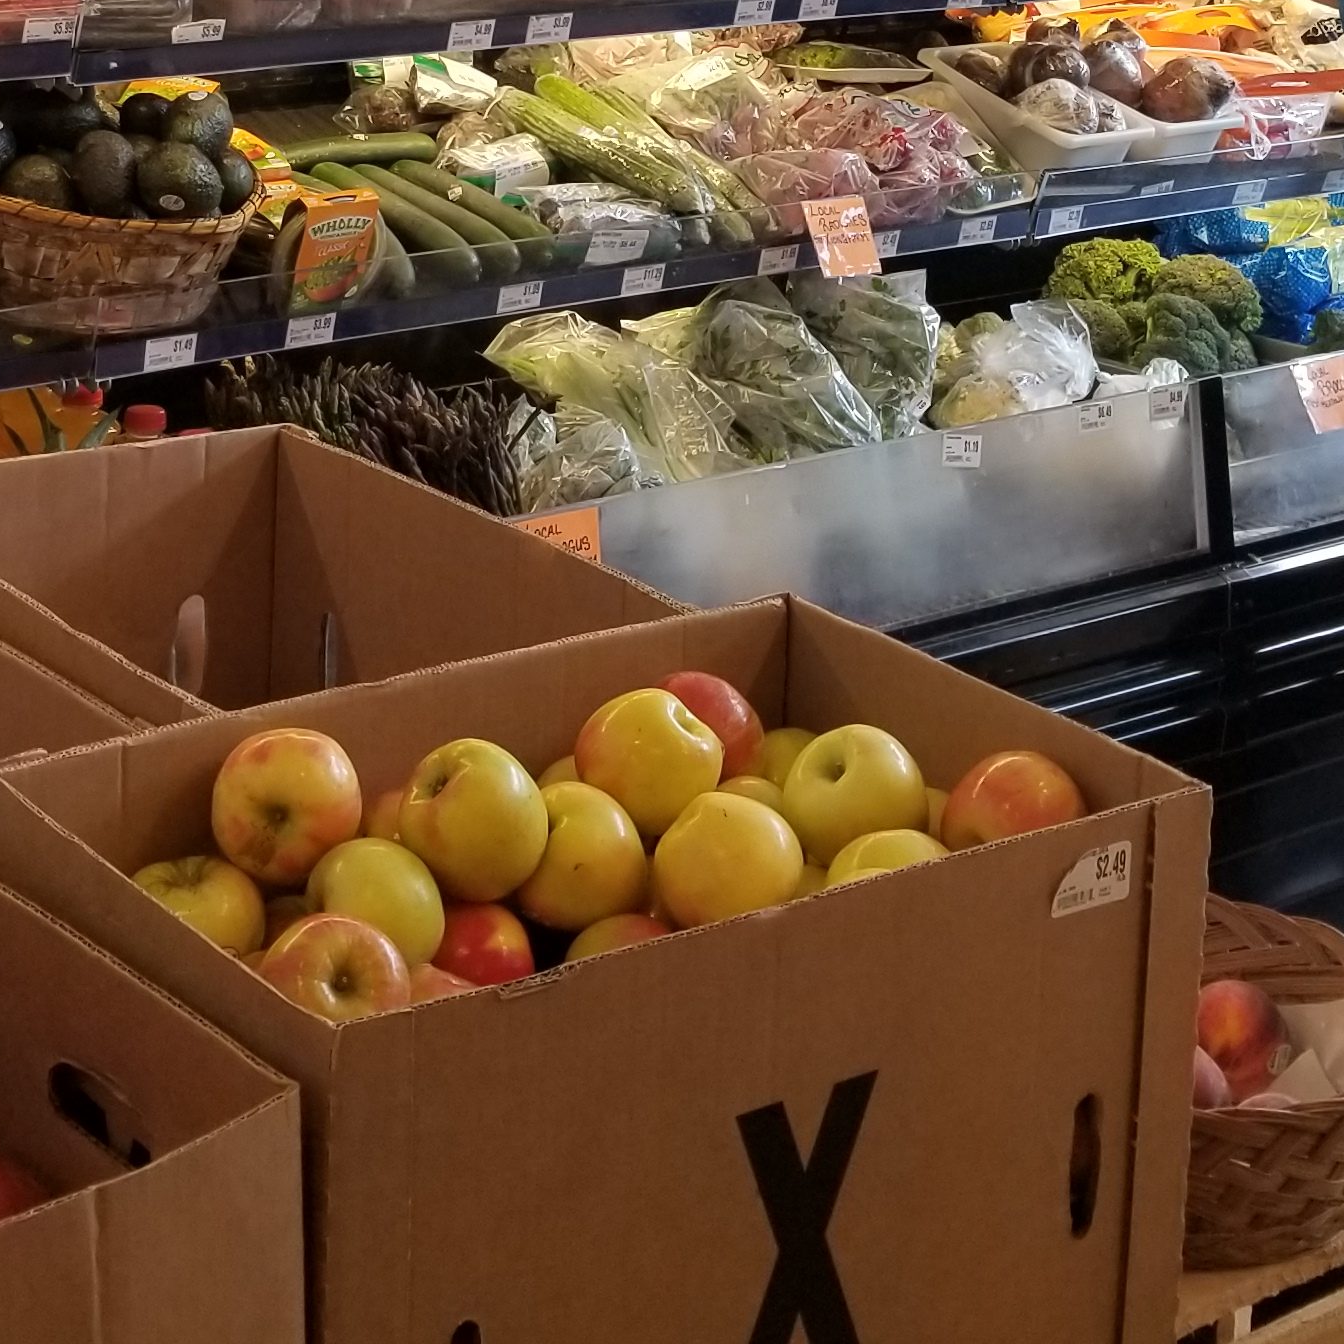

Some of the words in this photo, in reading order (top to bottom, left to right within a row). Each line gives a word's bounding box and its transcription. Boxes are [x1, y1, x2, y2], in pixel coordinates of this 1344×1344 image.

[53, 22, 74, 35] $5.99
[201, 25, 221, 38] $5.99
[808, 204, 841, 217] LOCAL
[311, 217, 372, 238] WHOLLY
[313, 316, 332, 331] $3.99
[173, 338, 193, 353] $1.49
[1096, 849, 1126, 880] $2.49
[735, 1068, 879, 1344] X
